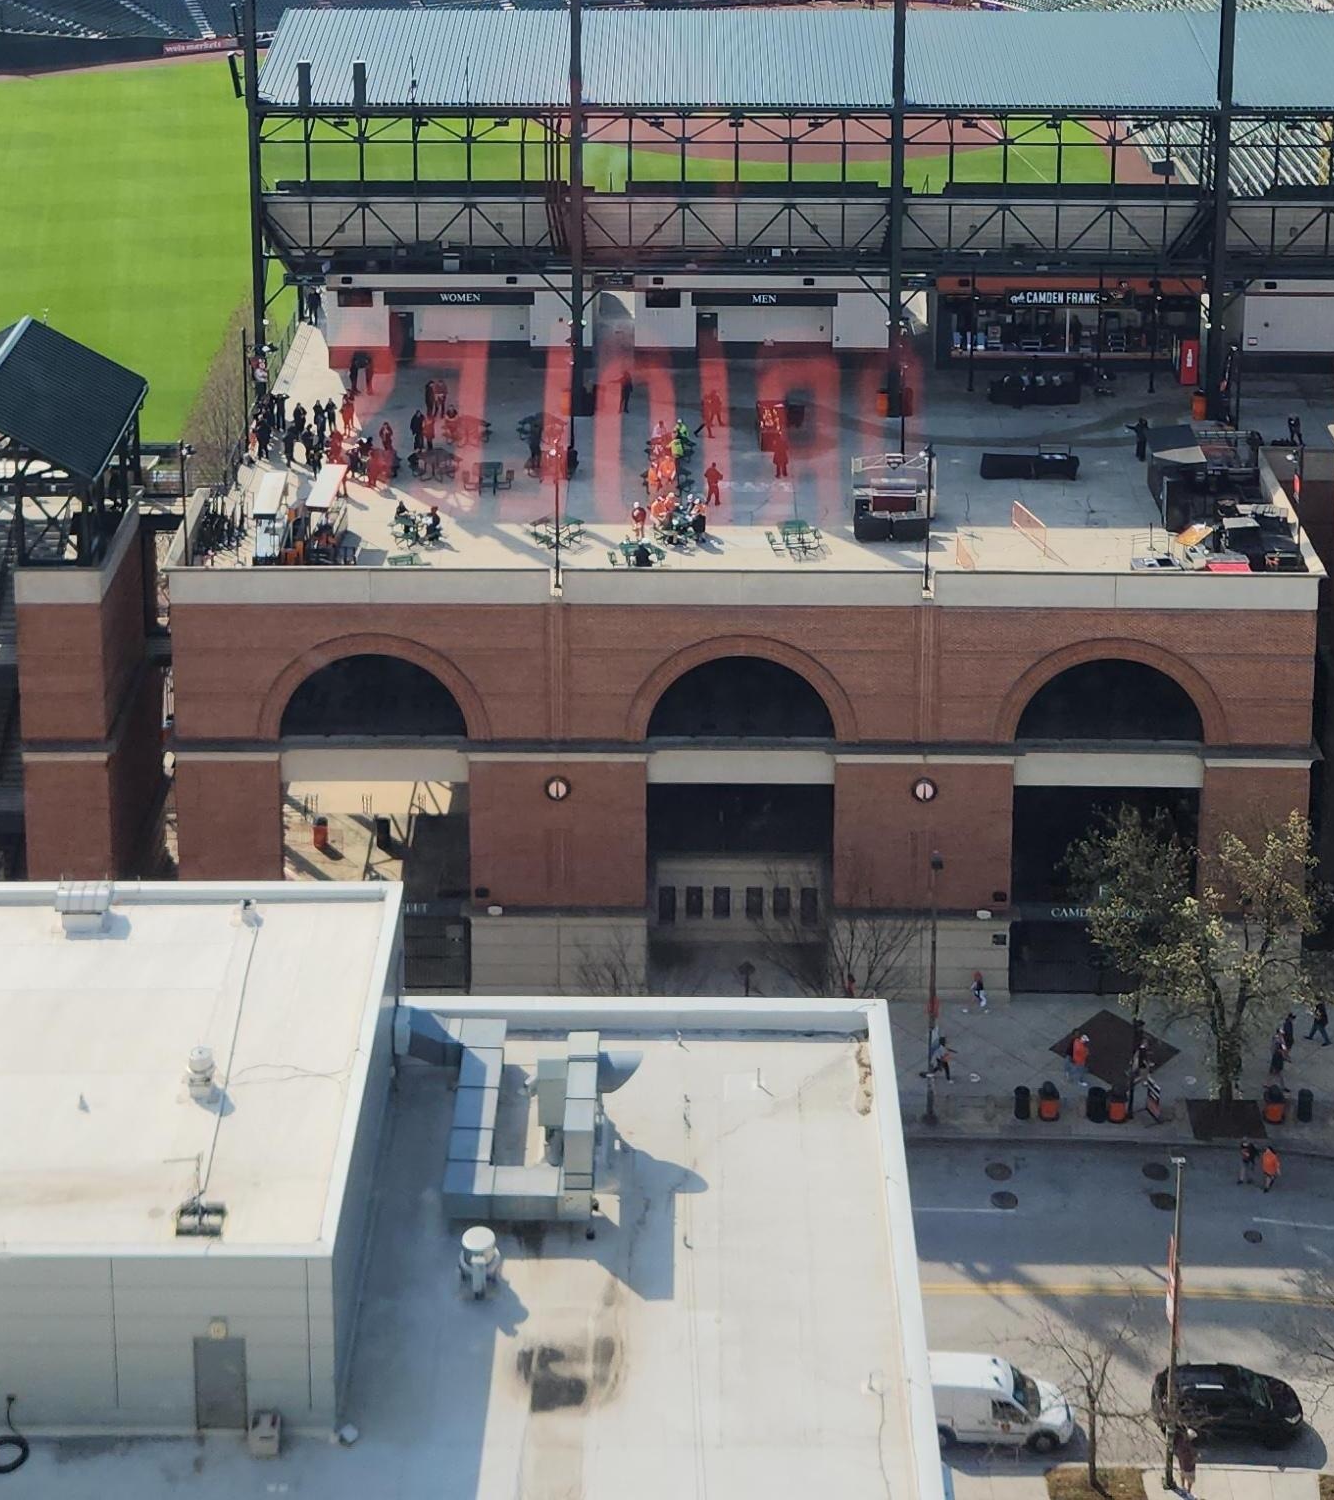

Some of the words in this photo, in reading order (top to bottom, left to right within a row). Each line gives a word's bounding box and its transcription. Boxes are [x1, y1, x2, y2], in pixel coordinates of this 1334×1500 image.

[439, 293, 481, 302] WOMEN
[752, 294, 777, 304] MEN
[1026, 291, 1064, 304] CAMDEN
